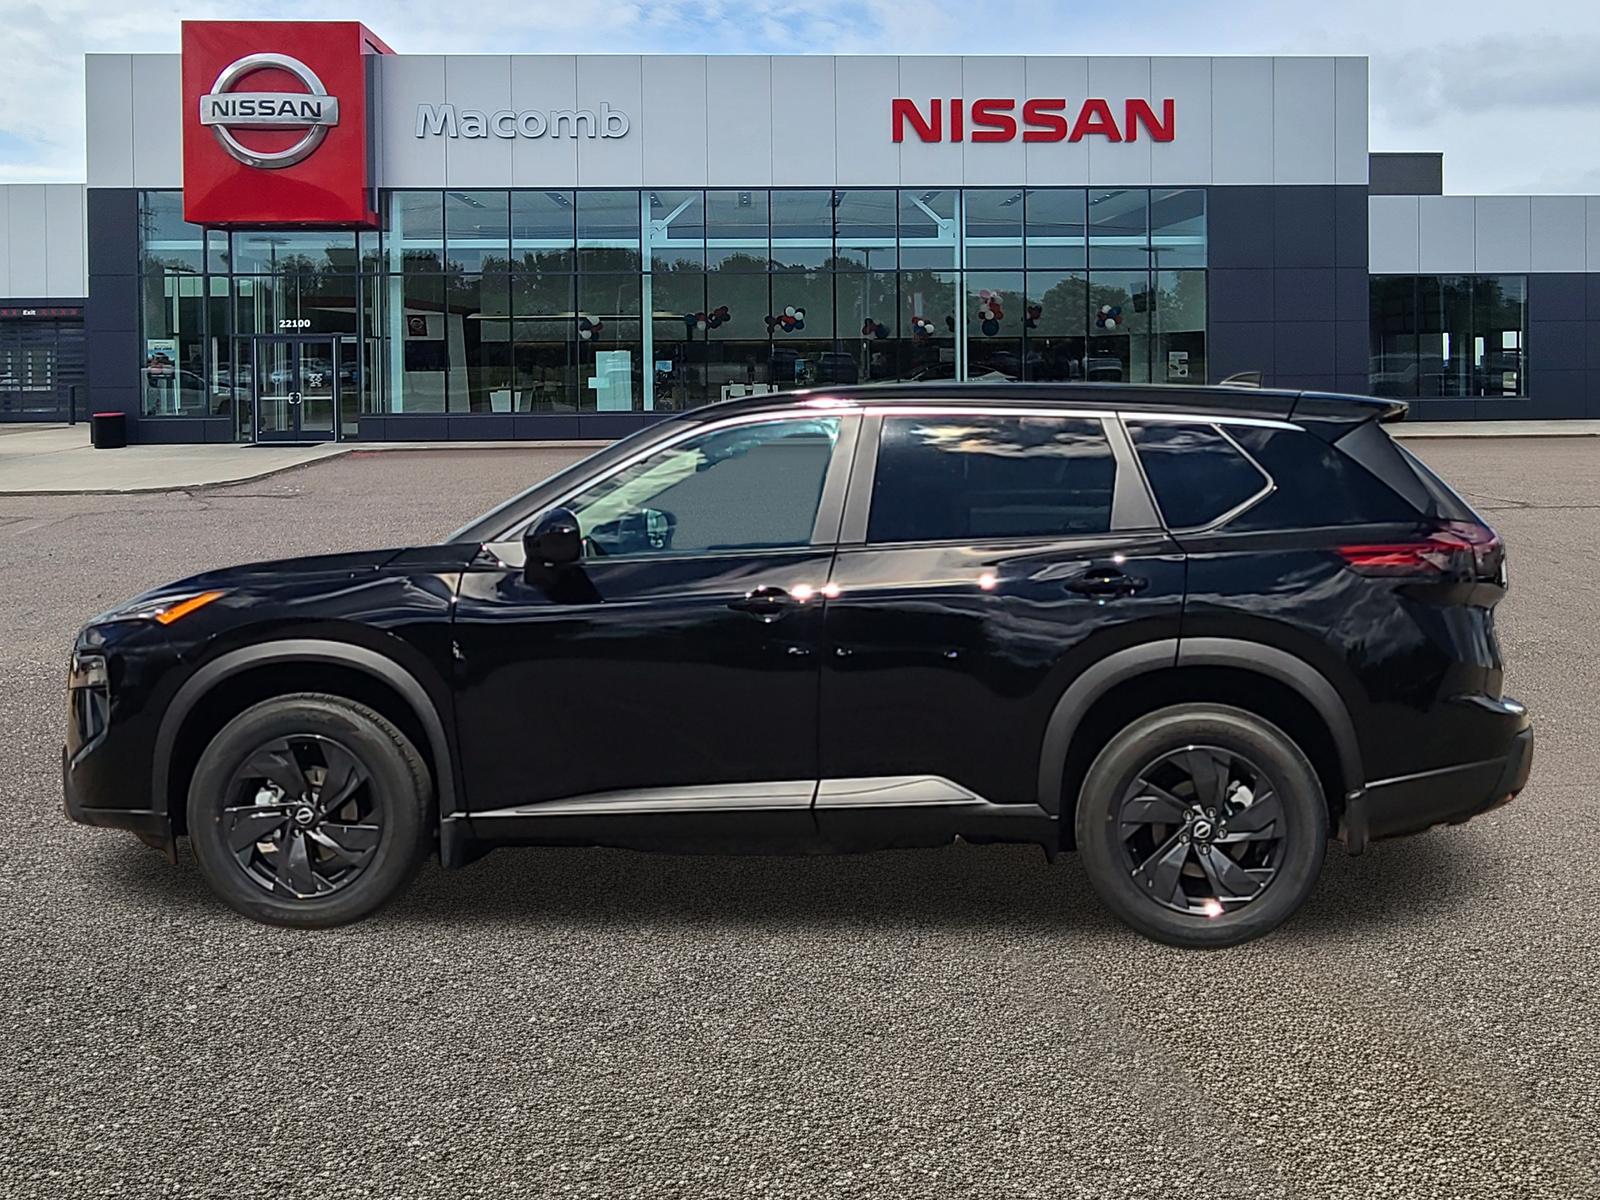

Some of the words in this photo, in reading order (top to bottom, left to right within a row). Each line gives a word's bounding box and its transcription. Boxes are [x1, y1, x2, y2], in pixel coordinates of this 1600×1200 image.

[211, 99, 322, 118] NISSAN
[415, 102, 630, 139] Macomb
[891, 98, 1175, 143] NISSAN
[279, 319, 311, 328] 22100
